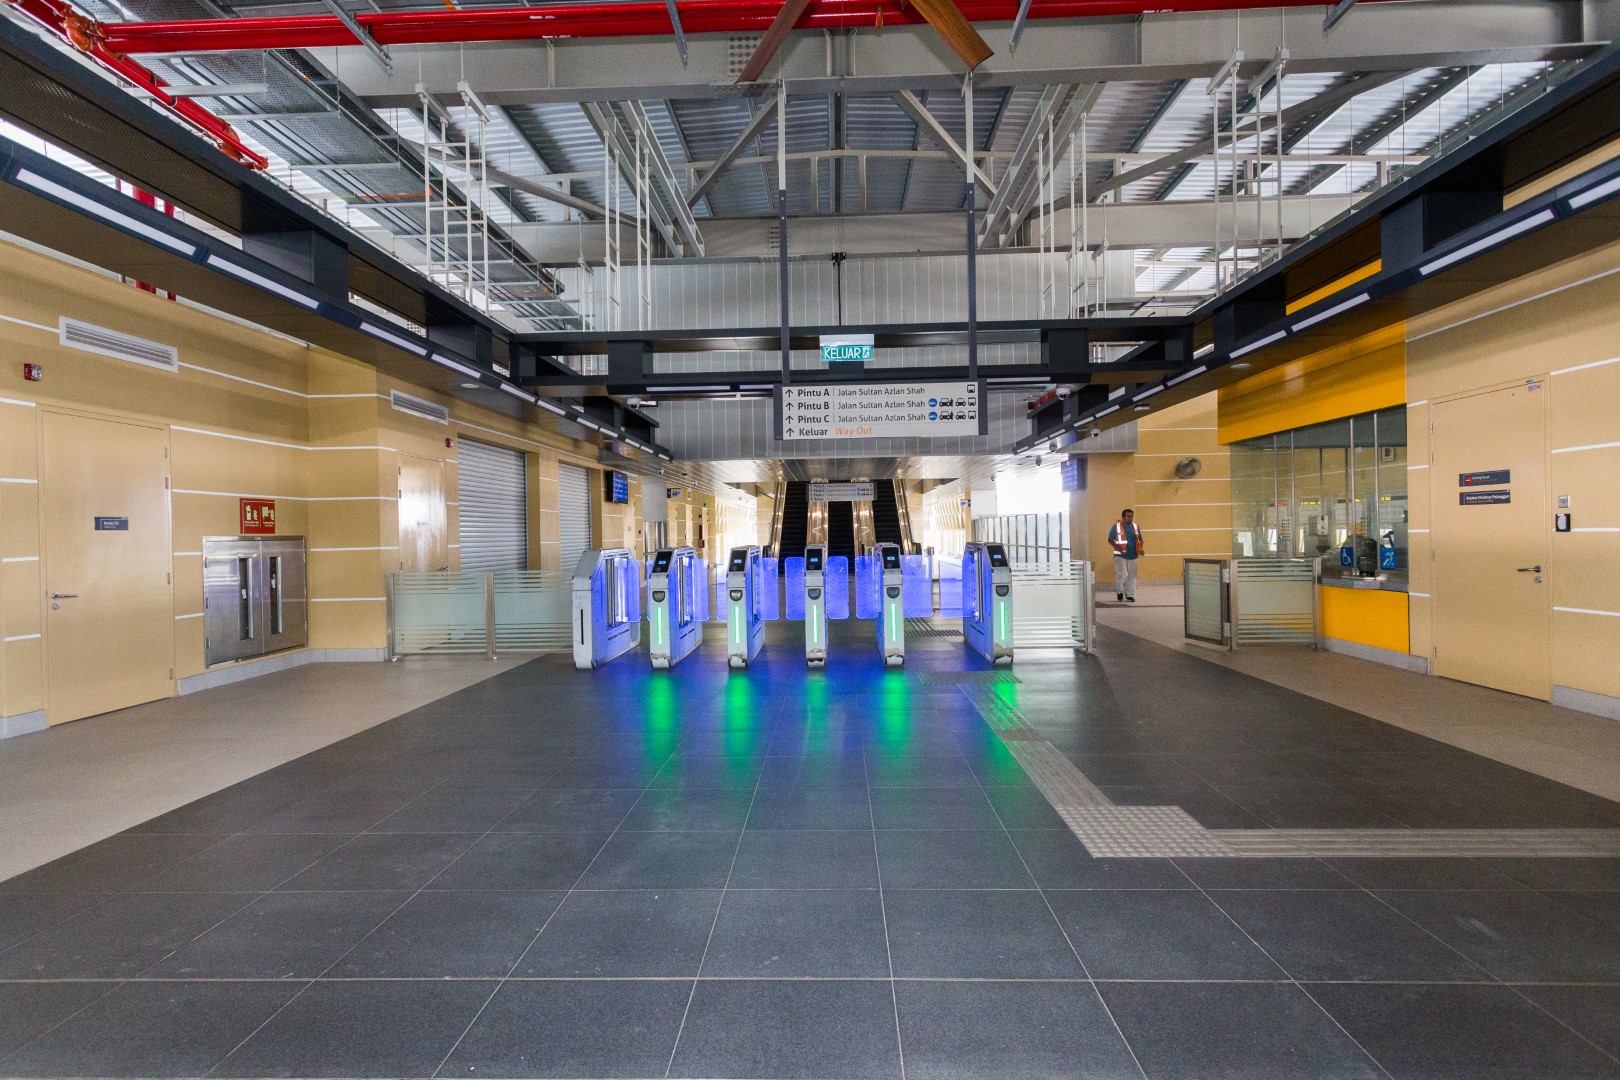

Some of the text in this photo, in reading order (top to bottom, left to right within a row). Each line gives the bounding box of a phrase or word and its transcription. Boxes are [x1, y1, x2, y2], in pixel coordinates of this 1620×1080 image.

[824, 347, 861, 359] KELUAR
[797, 386, 926, 397] Pintu A Jalan Sultan Azlan Shah
[797, 400, 926, 411] Pintu B Jalan Sultan Azlan Shah
[797, 413, 926, 424] Pintu C Jalan Sultan Azlan Shah
[799, 426, 873, 437] Keluar Way Out
